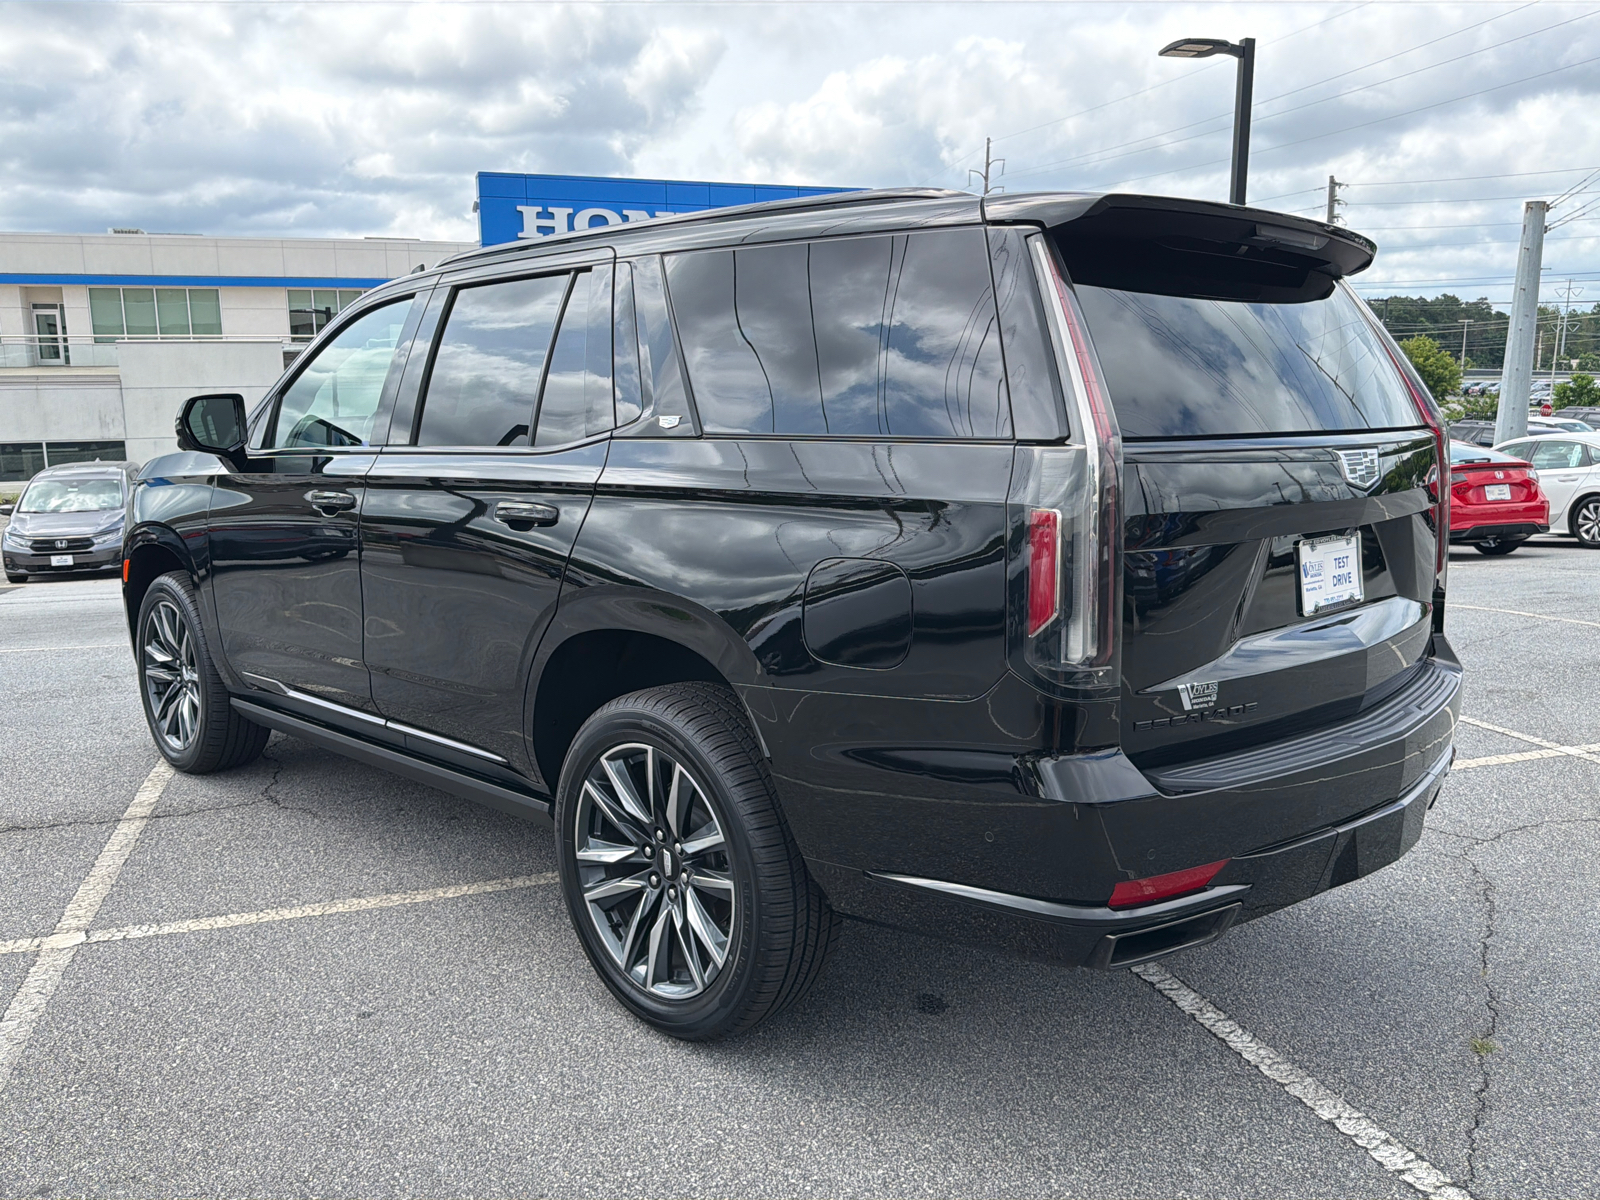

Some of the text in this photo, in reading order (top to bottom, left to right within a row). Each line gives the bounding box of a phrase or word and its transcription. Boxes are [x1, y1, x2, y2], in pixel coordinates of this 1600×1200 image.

[1333, 555, 1350, 570] TEST
[1332, 572, 1352, 587] DRIVE
[1186, 682, 1218, 699] VOYLES
[1191, 696, 1211, 704] HONDA
[1133, 701, 1258, 732] ESCALADE
